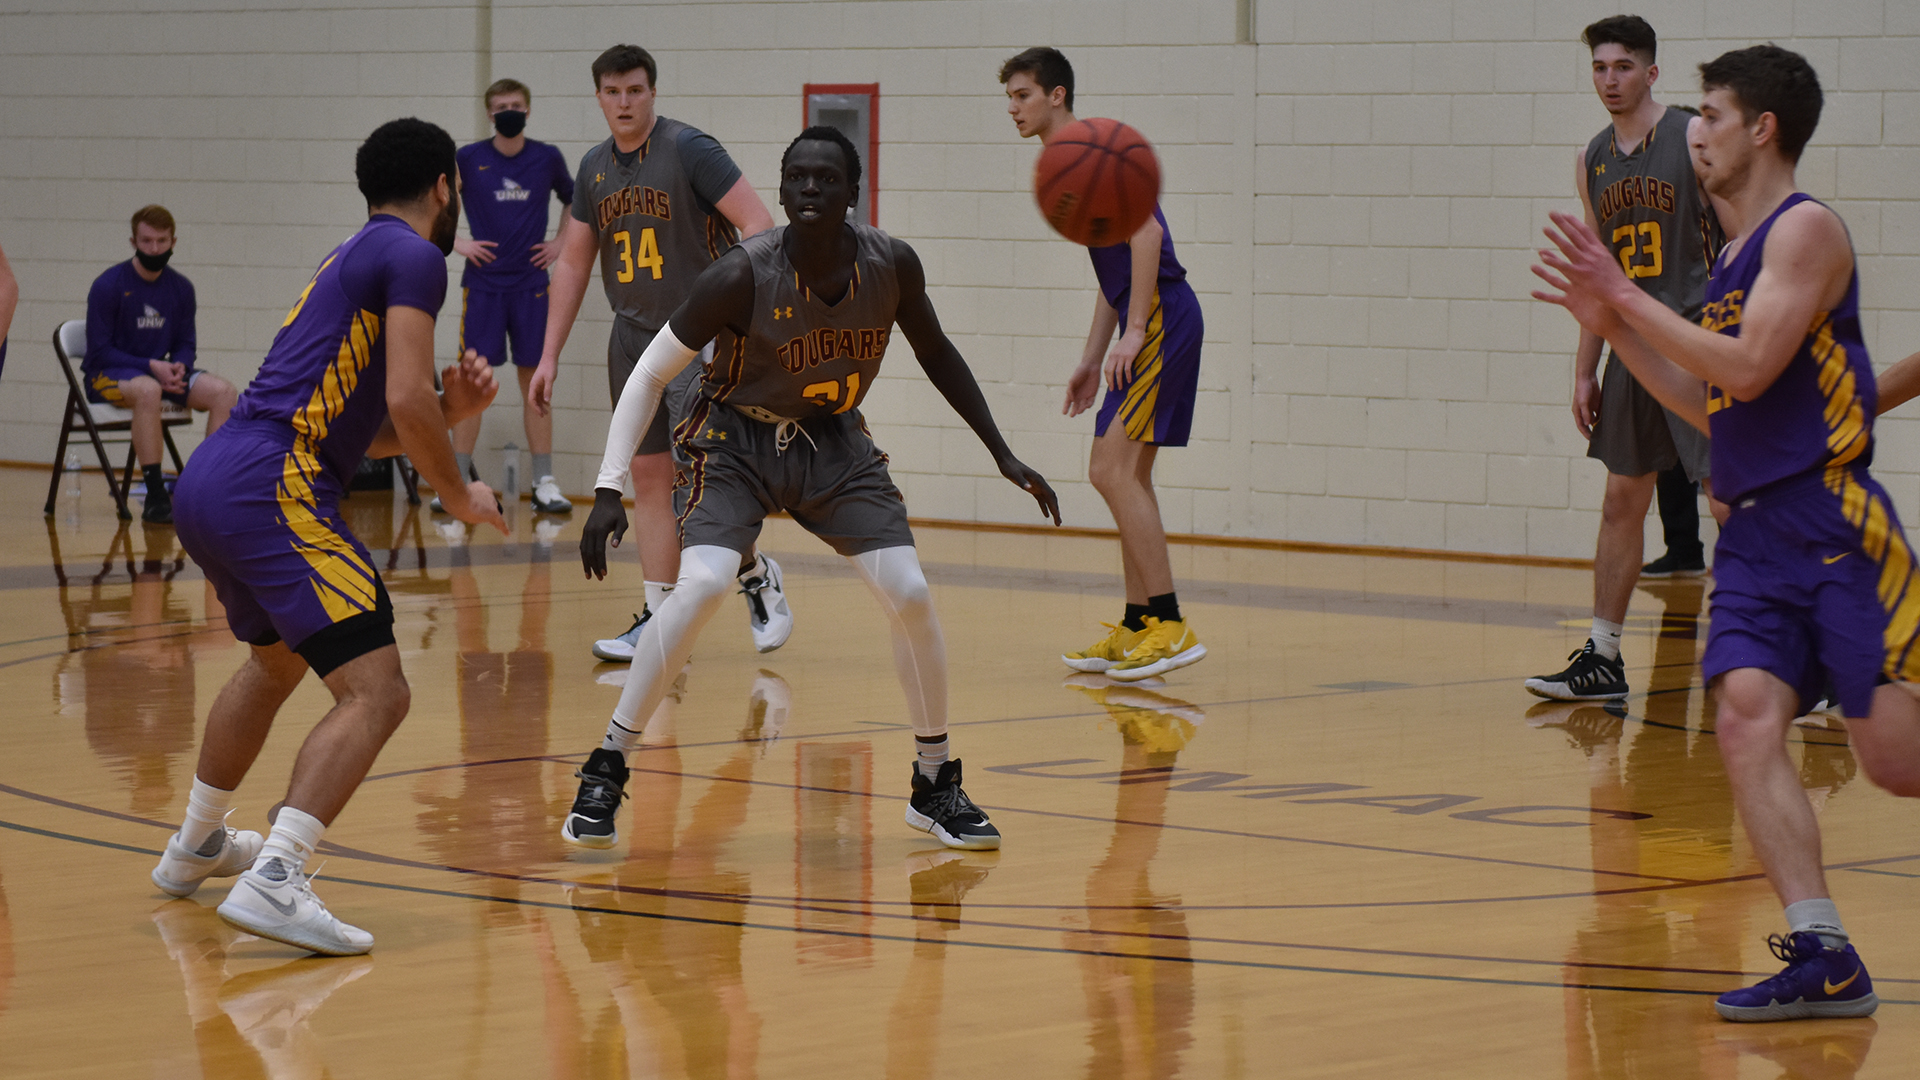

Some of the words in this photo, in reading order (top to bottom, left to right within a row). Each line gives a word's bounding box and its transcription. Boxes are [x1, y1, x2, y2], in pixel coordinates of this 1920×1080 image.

[493, 189, 531, 202] UNW
[597, 185, 672, 231] COUGARS
[613, 227, 664, 284] 34
[1612, 220, 1663, 279] 23
[137, 316, 166, 329] UNW
[777, 327, 886, 375] COUGARS
[982, 757, 1655, 829] UMAC
